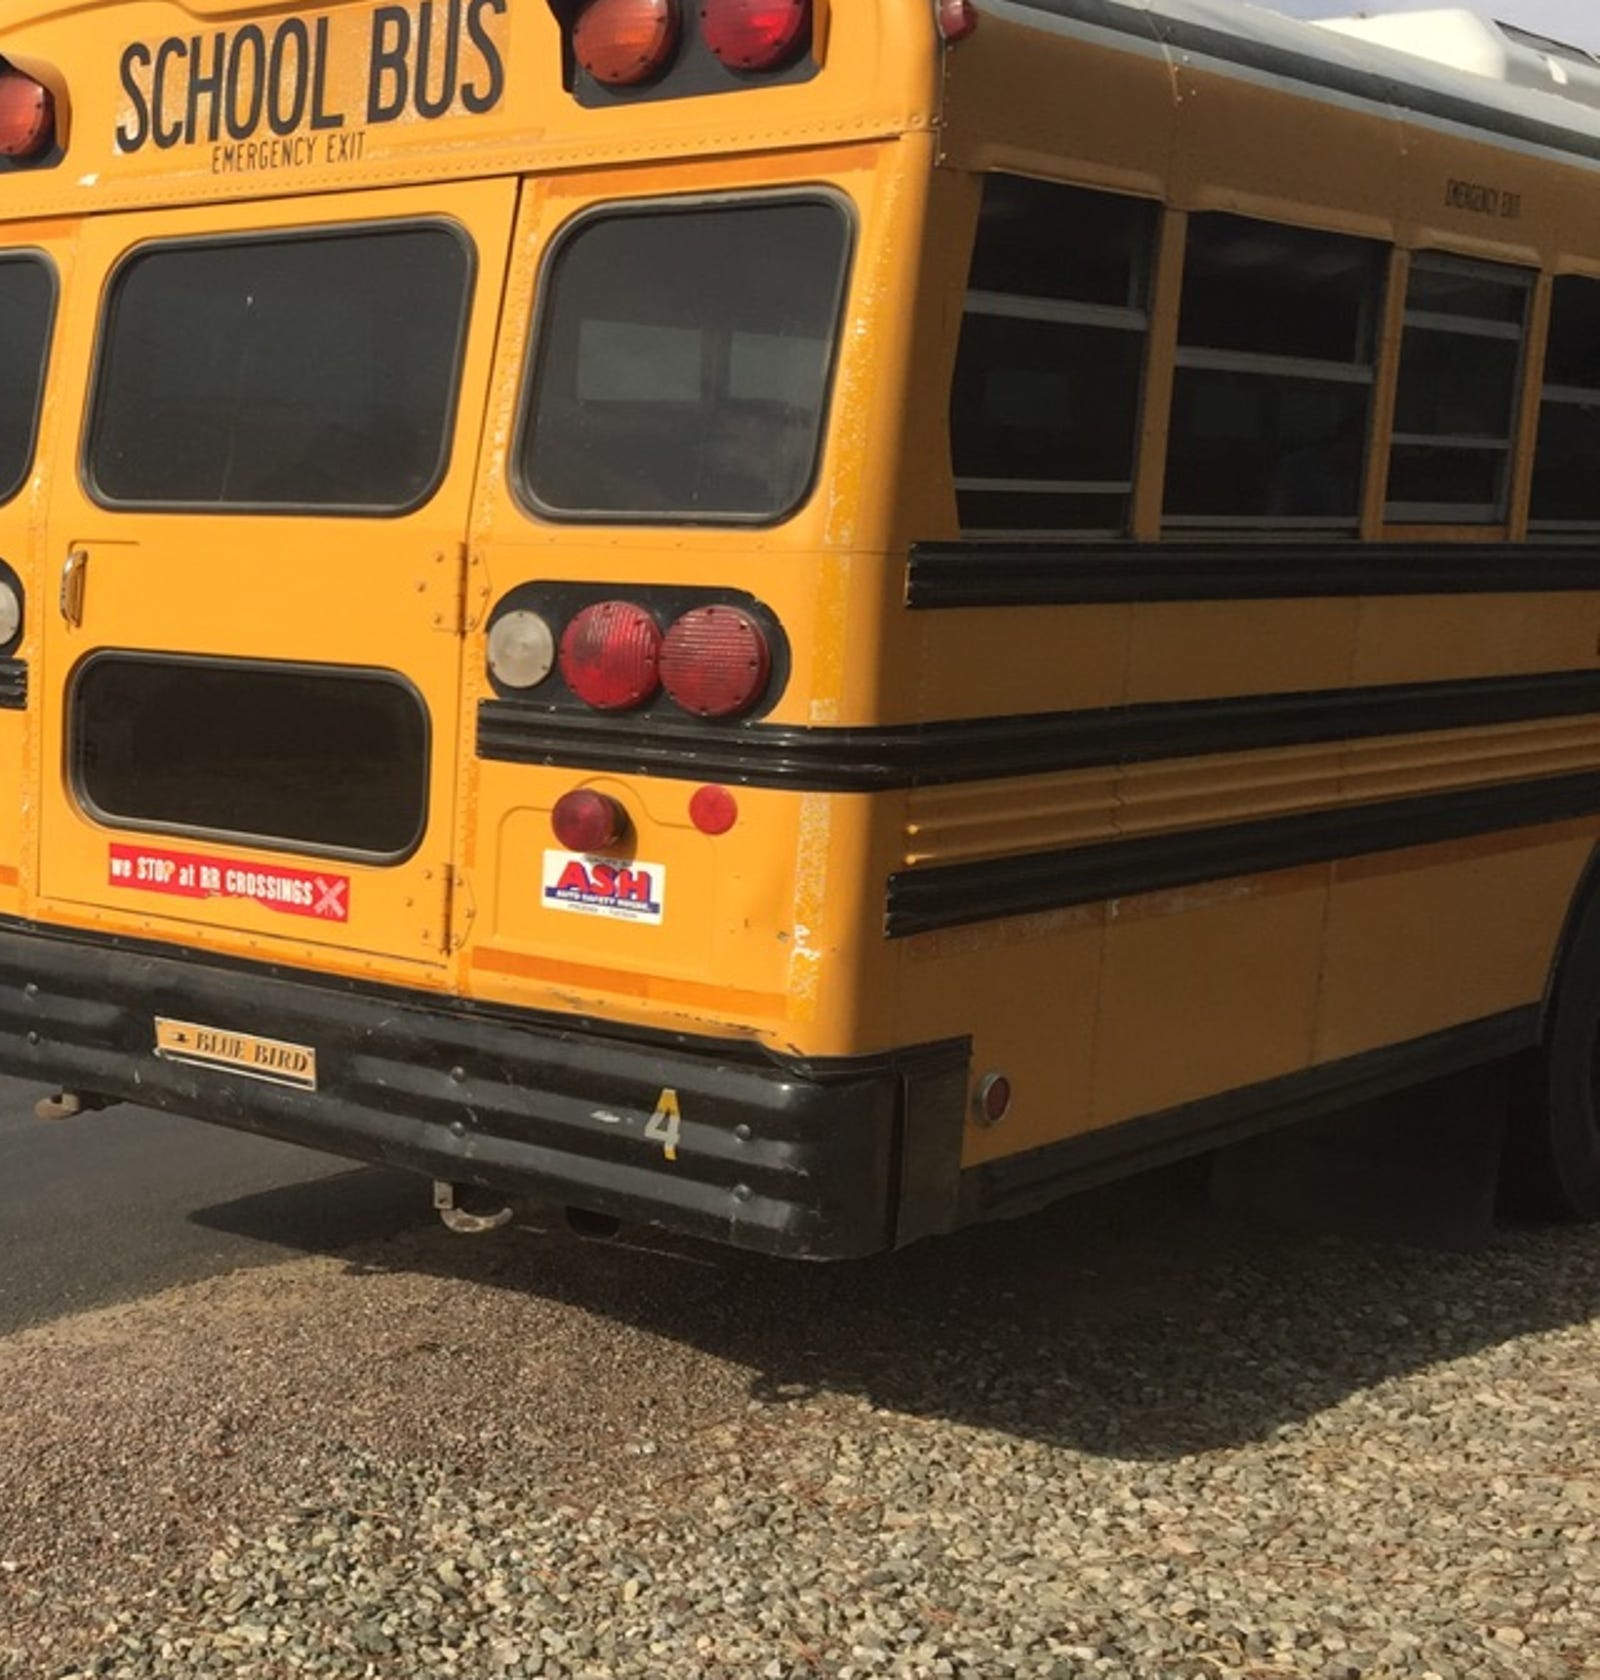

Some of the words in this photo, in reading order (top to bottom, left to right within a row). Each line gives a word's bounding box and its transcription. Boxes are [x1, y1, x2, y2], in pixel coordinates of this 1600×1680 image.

[116, 16, 344, 154] SCHOOL
[367, 0, 508, 125] BUS
[211, 136, 318, 175] EMERGENCY
[327, 132, 366, 164] EXIT
[111, 858, 132, 878] we
[137, 856, 176, 884] STOP
[179, 864, 196, 887] at
[200, 866, 221, 890] RR
[226, 869, 314, 907] CROSSINGS
[557, 860, 652, 904] ASH
[196, 1033, 247, 1060] BLUE
[254, 1044, 309, 1072] BIRD
[644, 1088, 680, 1160] 4
